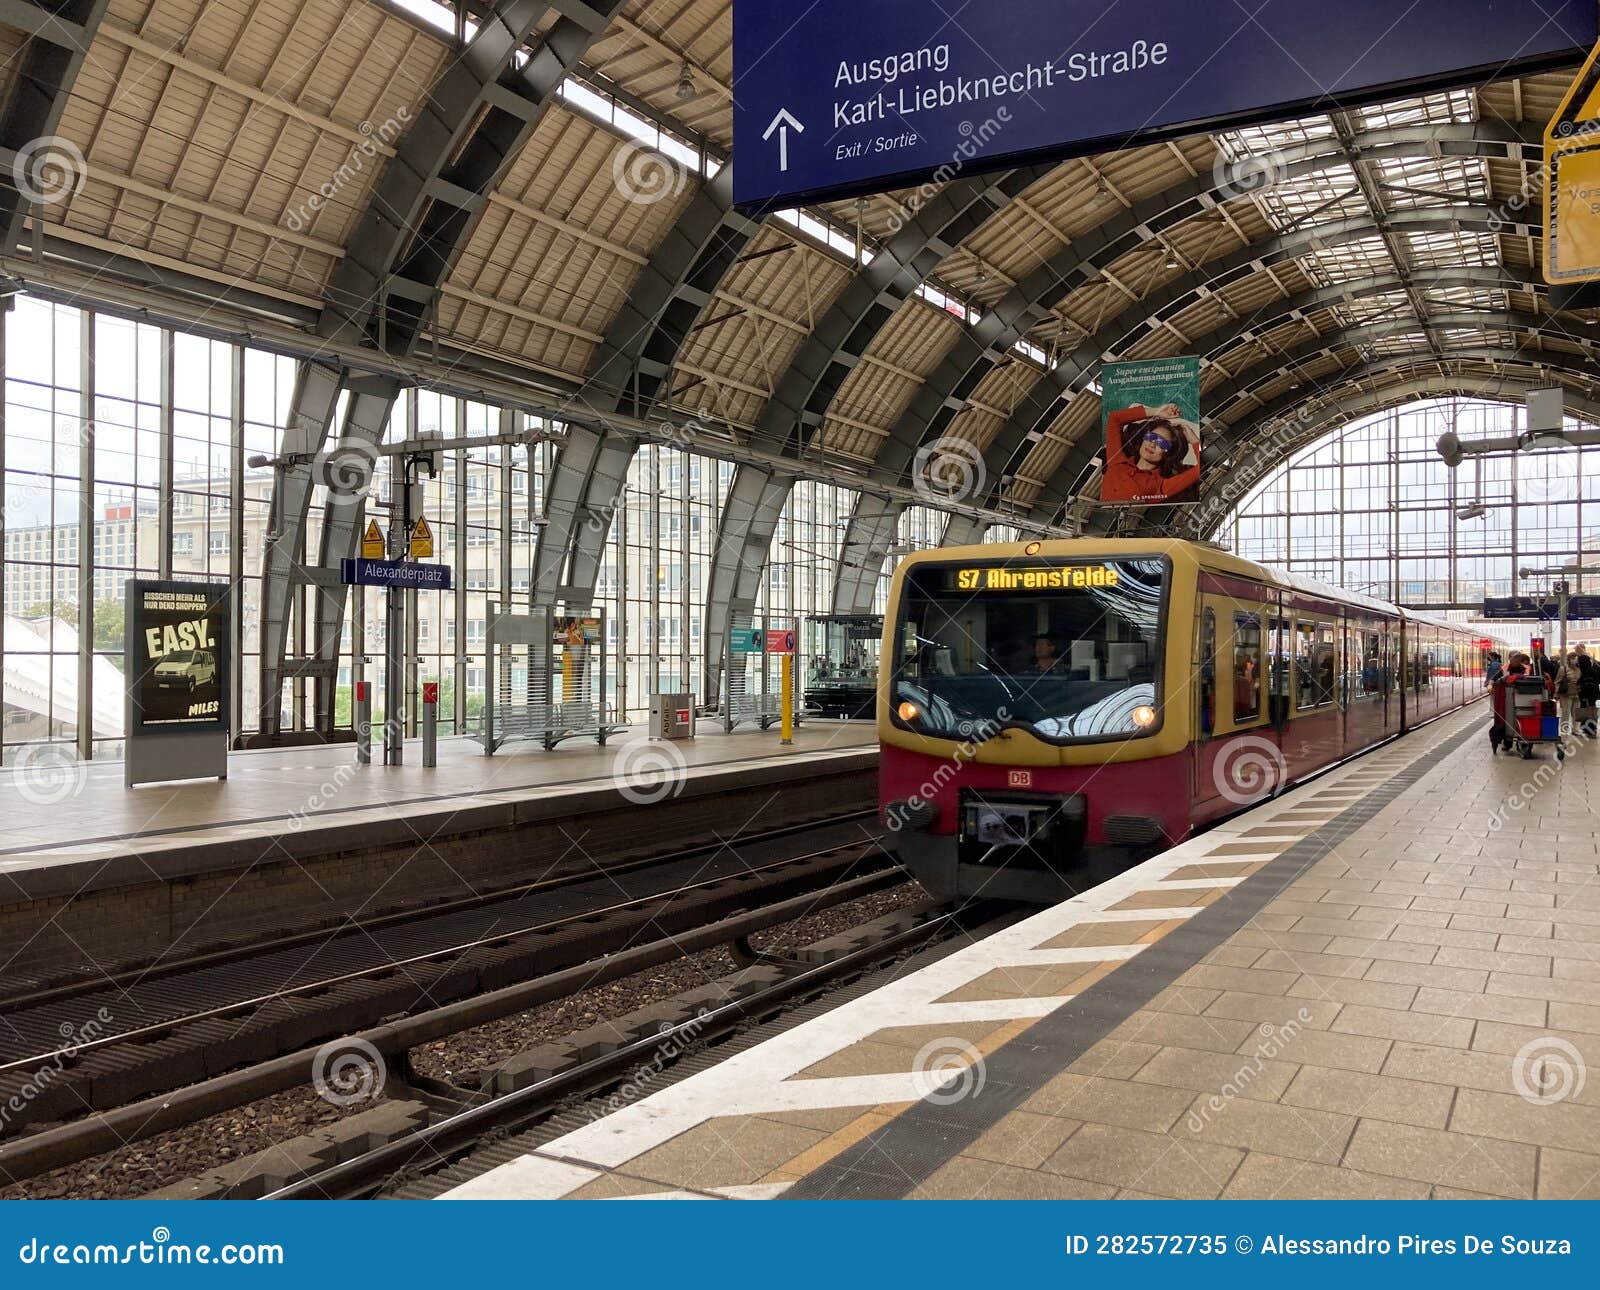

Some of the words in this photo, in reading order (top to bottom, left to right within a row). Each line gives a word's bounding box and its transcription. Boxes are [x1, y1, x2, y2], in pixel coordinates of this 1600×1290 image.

[834, 42, 950, 88] Ausgang
[833, 40, 1168, 128] Karl-Liebknecht-Straße
[835, 142, 862, 161] Exit
[865, 140, 872, 156] /
[875, 132, 918, 154] Sortie
[1107, 371, 1194, 385] Ausgabenmanagement
[364, 563, 443, 583] Alexanderplatz
[958, 569, 980, 589] S7
[987, 566, 1119, 589] Ahrensfelde
[144, 591, 175, 601] BISSCHEN
[176, 593, 194, 602] MEHR
[194, 594, 206, 603] ALS
[144, 600, 158, 609] NUR
[176, 602, 208, 611] SHOPPEN?
[145, 618, 215, 659] EASY.
[188, 700, 219, 716] MILES
[1010, 771, 1029, 785] DB
